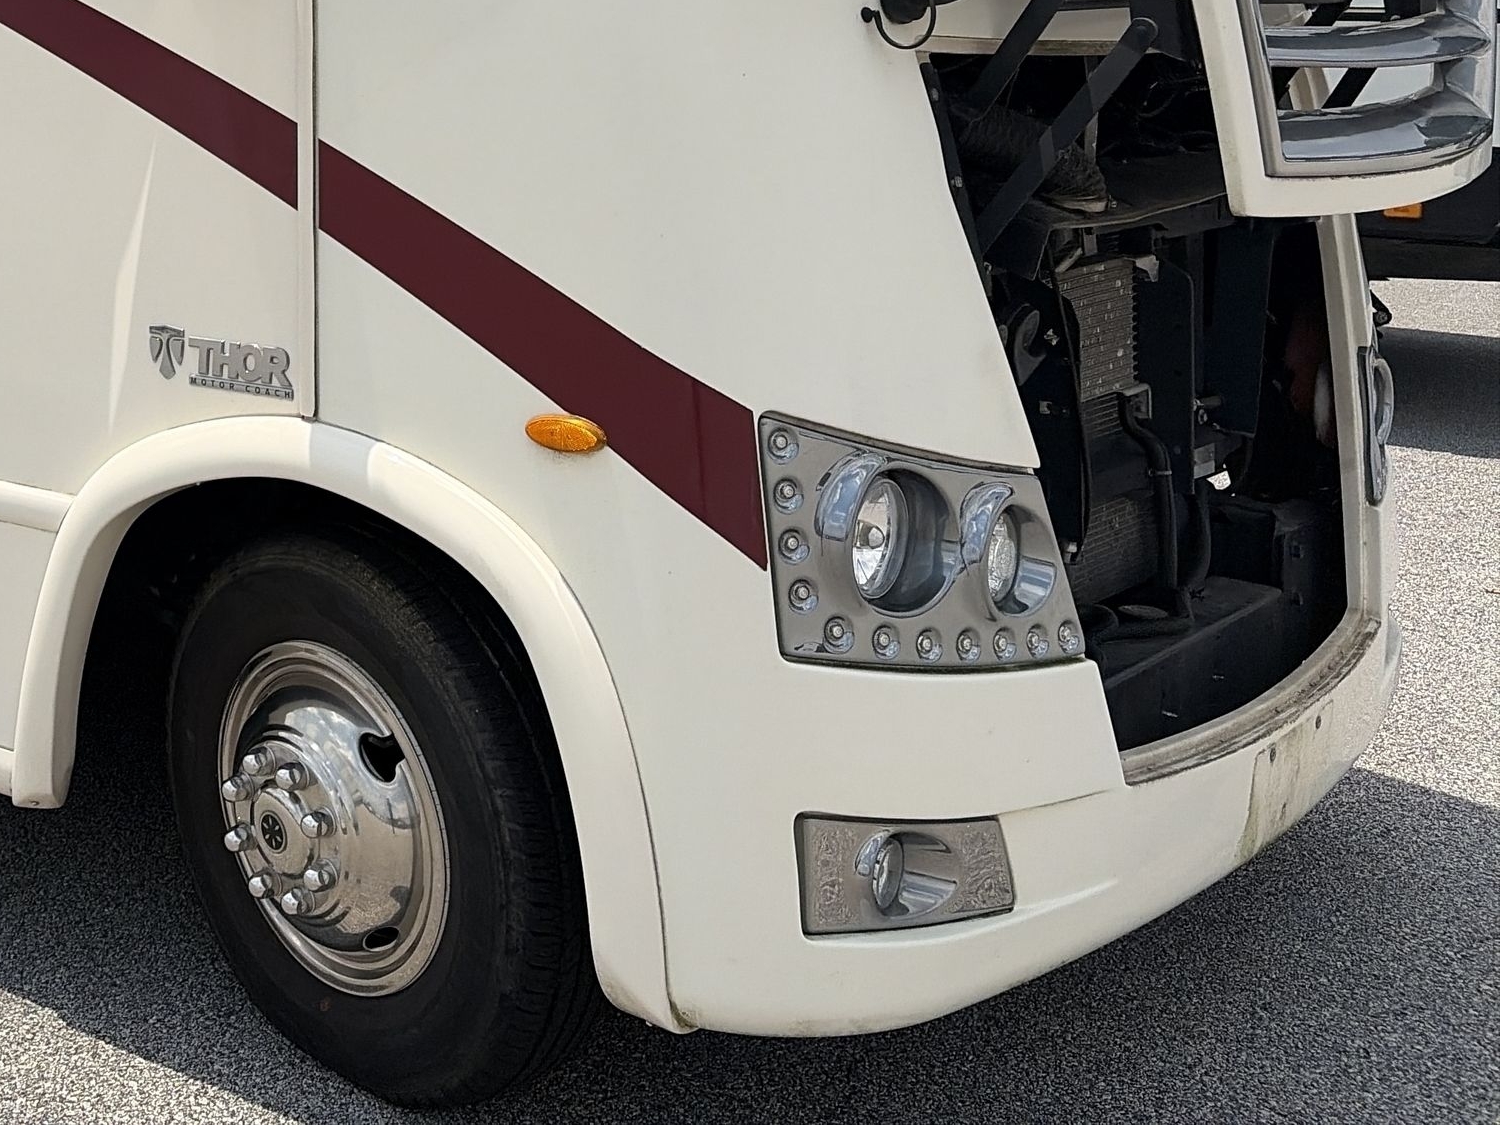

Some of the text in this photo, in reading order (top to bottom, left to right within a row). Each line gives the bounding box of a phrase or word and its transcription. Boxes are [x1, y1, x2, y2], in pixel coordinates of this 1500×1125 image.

[188, 335, 293, 388] THOR
[190, 377, 291, 399] MOTOR COACH
